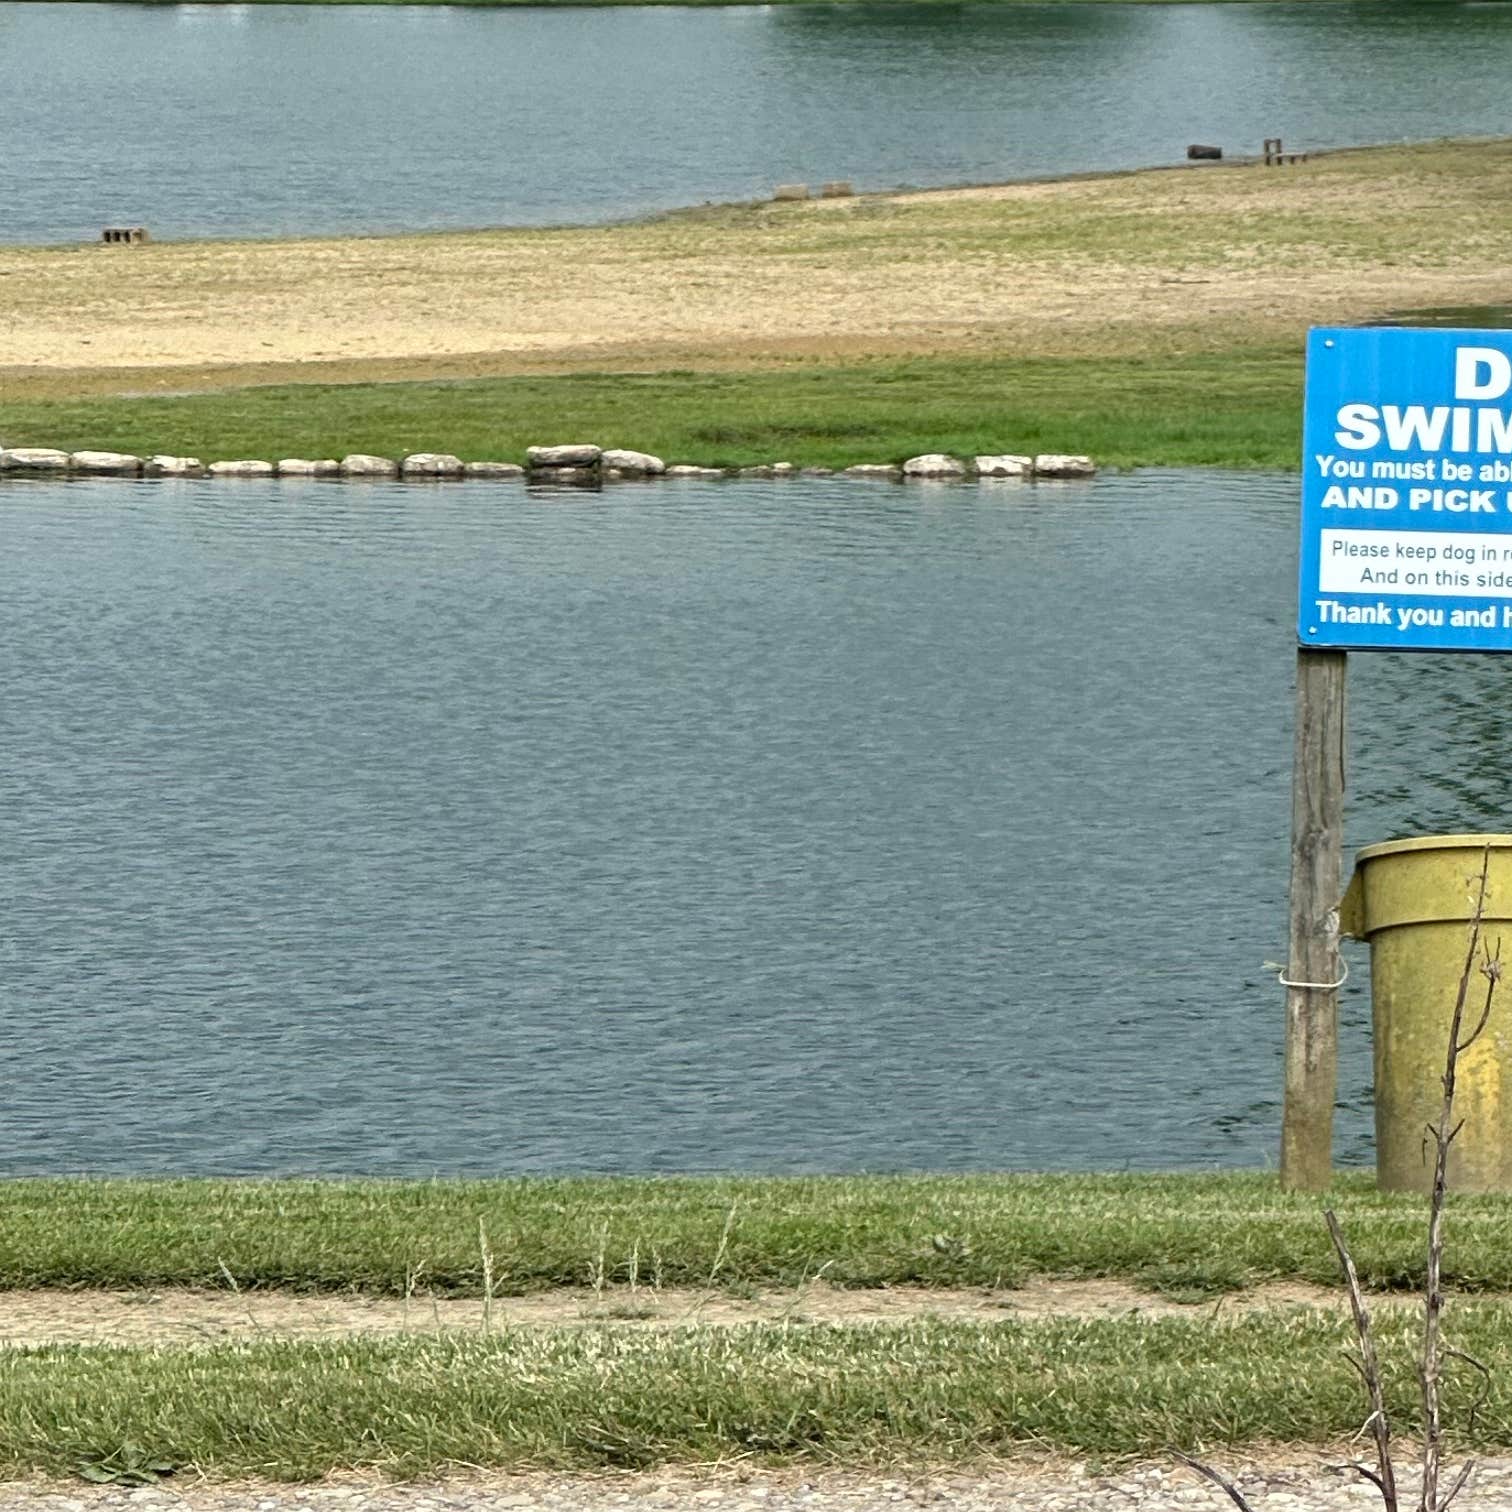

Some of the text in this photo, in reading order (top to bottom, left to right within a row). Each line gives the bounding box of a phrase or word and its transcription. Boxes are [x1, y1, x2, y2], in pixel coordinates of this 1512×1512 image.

[1316, 456, 1365, 478] You
[1372, 460, 1435, 480] must
[1442, 459, 1471, 481] be
[1321, 486, 1398, 510] AND
[1409, 489, 1496, 513] PICK
[1332, 541, 1390, 558] Please
[1396, 542, 1437, 563] keep
[1442, 544, 1476, 564] dog
[1482, 545, 1497, 561] in
[1361, 568, 1398, 585] And
[1405, 570, 1429, 586] on
[1435, 569, 1469, 587] this
[1316, 601, 1391, 625] Thank
[1397, 608, 1444, 631] you
[1451, 607, 1497, 628] and
